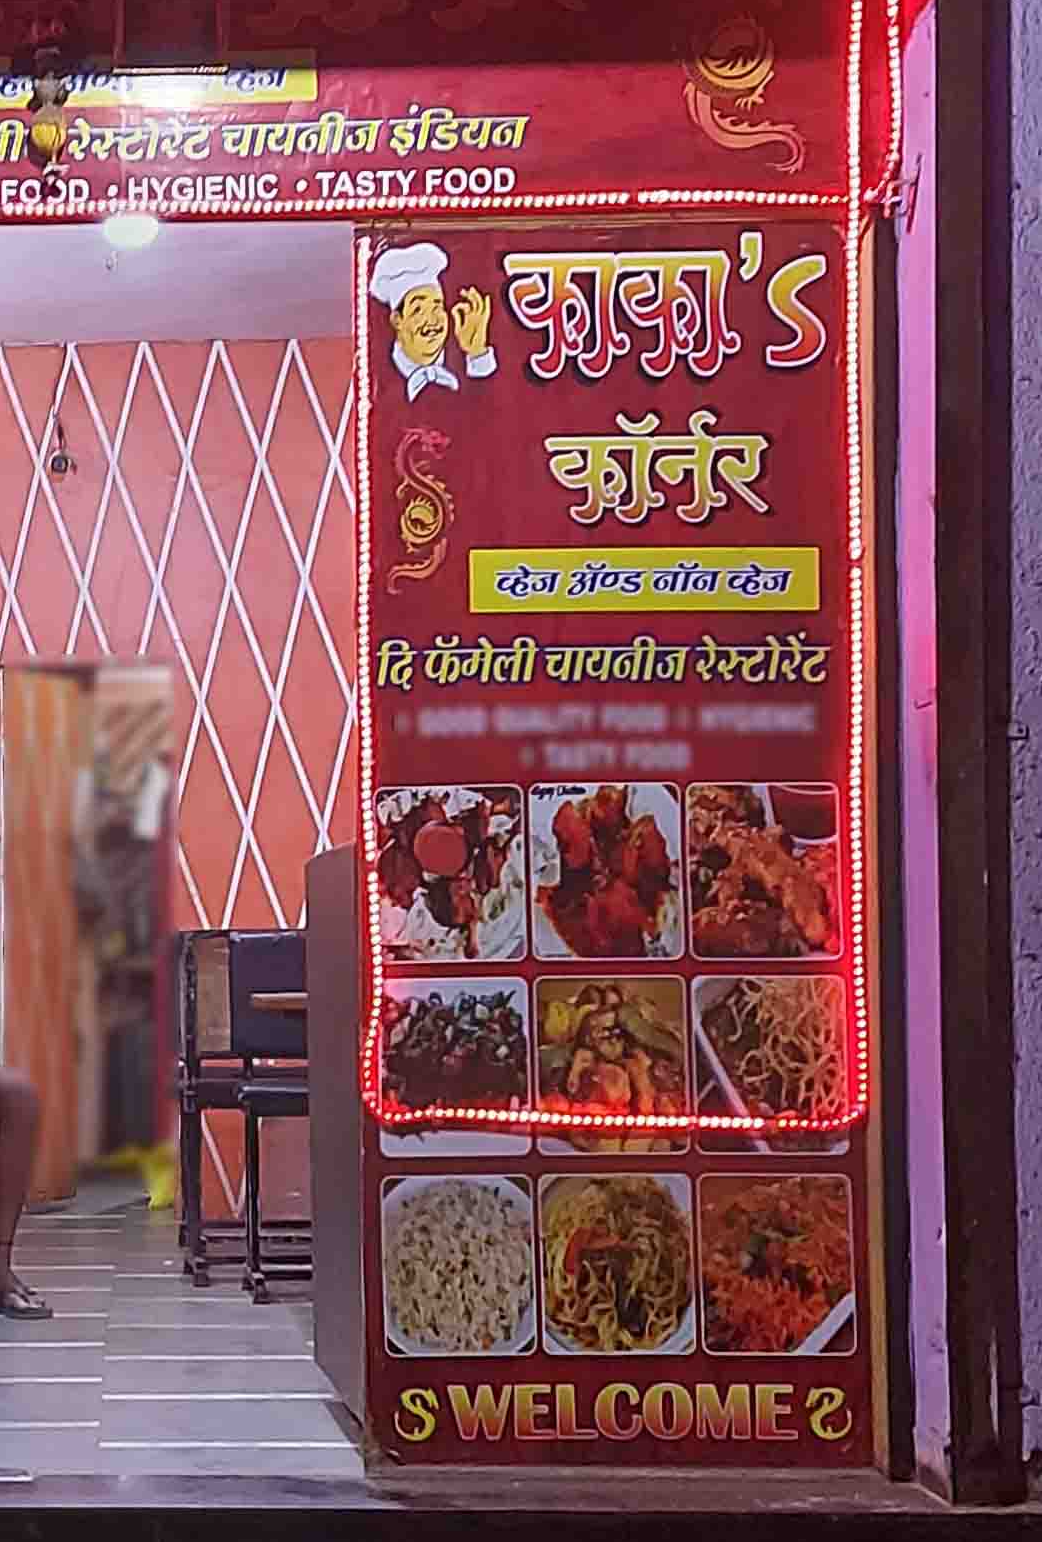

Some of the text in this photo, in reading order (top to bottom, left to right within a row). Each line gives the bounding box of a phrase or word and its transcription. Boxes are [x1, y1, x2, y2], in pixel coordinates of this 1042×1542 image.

[221, 110, 385, 157] चायनीज
[388, 103, 531, 157] इंडियन
[127, 172, 279, 203] HYGIENIC
[314, 168, 418, 198] TASTY
[424, 166, 517, 196] FOOD
[544, 410, 770, 525] कॉर्नर
[495, 565, 559, 597] व्हेज
[652, 562, 719, 594] नॉन
[726, 563, 792, 595] व्हेज
[376, 631, 832, 690] दि फॅमेली चायनीज रेस्टोरेंट
[446, 1381, 800, 1441] WELCOME
